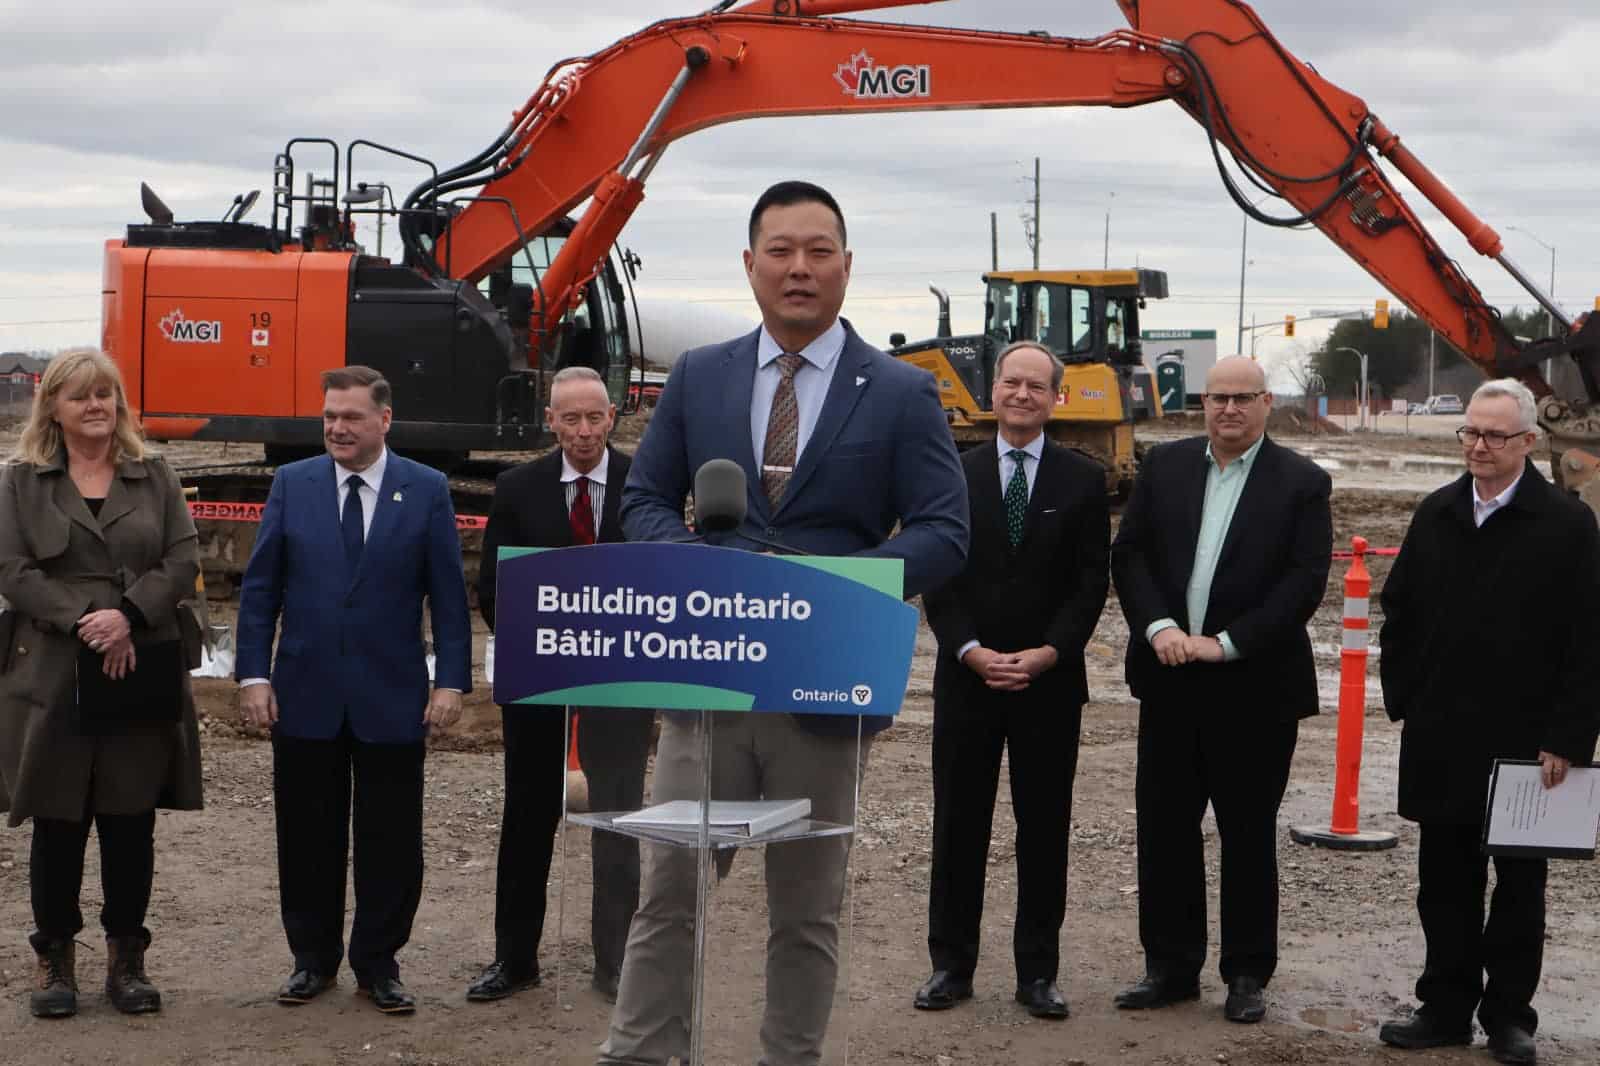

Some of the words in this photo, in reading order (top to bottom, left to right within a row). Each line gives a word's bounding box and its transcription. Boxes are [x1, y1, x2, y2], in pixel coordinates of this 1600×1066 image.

[858, 67, 928, 96] MGI
[173, 321, 220, 341] MGI
[250, 312, 271, 328] 19
[537, 585, 678, 623] Building
[686, 590, 812, 621] Ontario
[535, 628, 616, 657] Bâtir
[792, 688, 849, 703] Ontario
